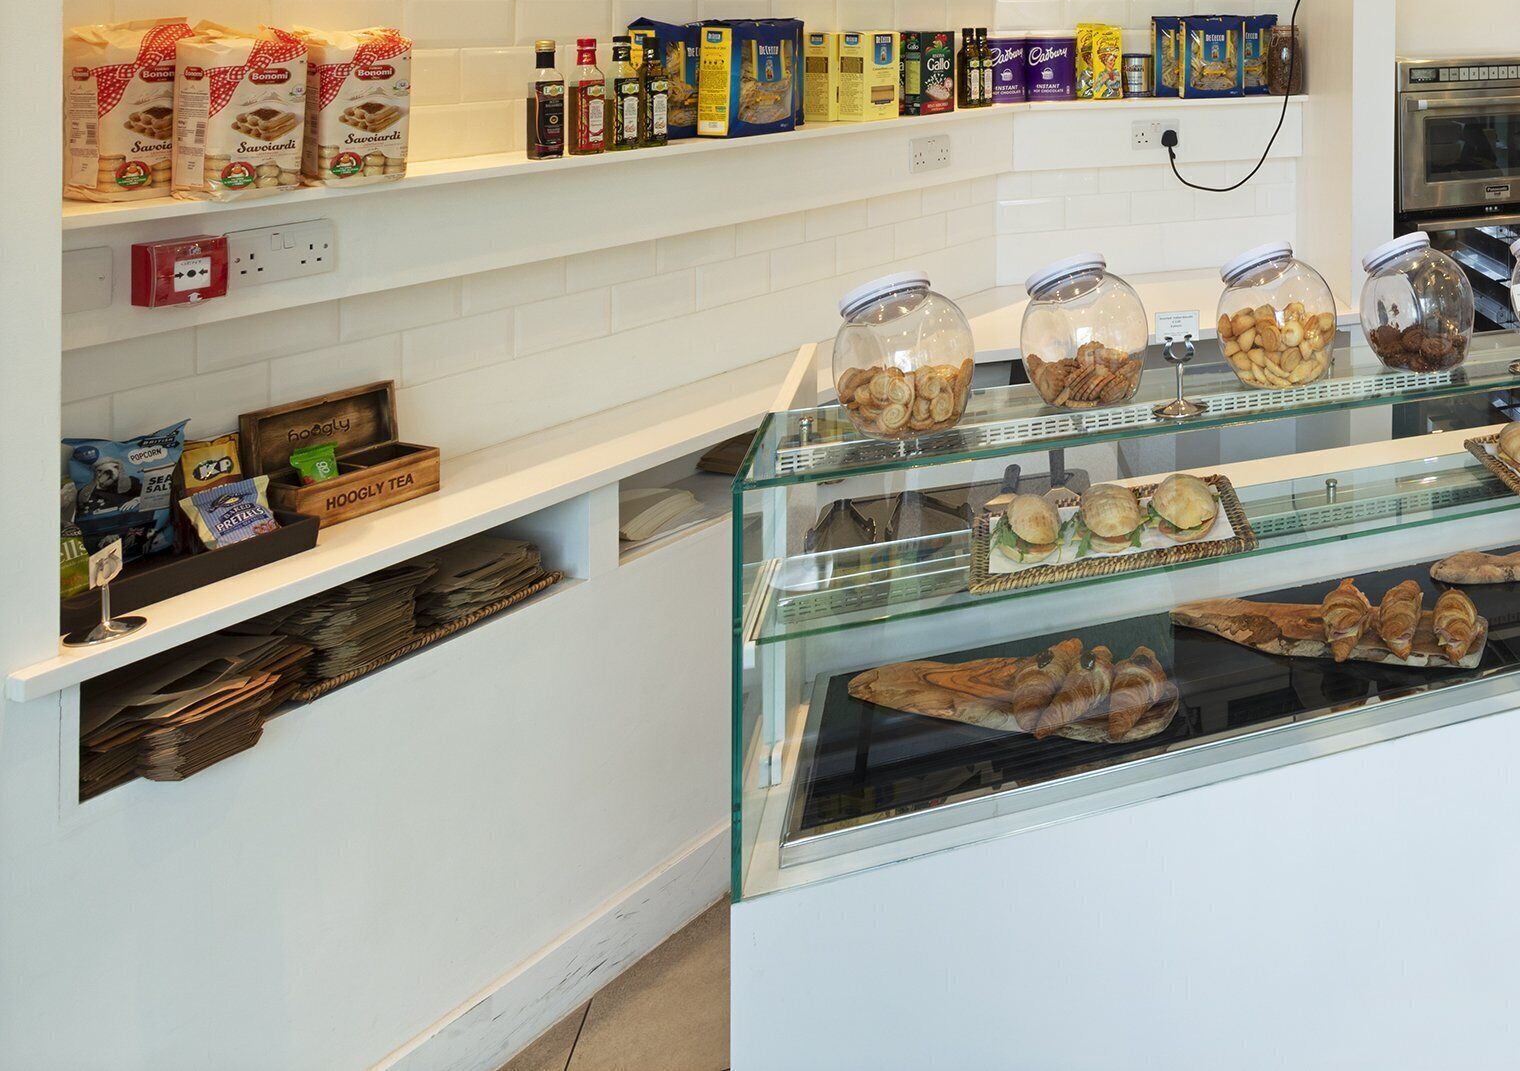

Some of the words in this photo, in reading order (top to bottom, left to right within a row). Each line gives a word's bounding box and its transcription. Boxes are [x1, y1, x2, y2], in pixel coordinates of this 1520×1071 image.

[1028, 46, 1068, 66] Cadbury
[927, 58, 950, 71] Gallo
[252, 72, 288, 81] Bonomi
[358, 67, 392, 77] Bonomi
[344, 131, 401, 144] Savoiardi
[237, 140, 297, 153] Savoiardi
[288, 418, 351, 442] hoogly
[130, 448, 162, 461] POPCORN
[326, 481, 385, 510] HOOGLY
[388, 473, 414, 490] TEA
[216, 508, 264, 532] PRETZELS
